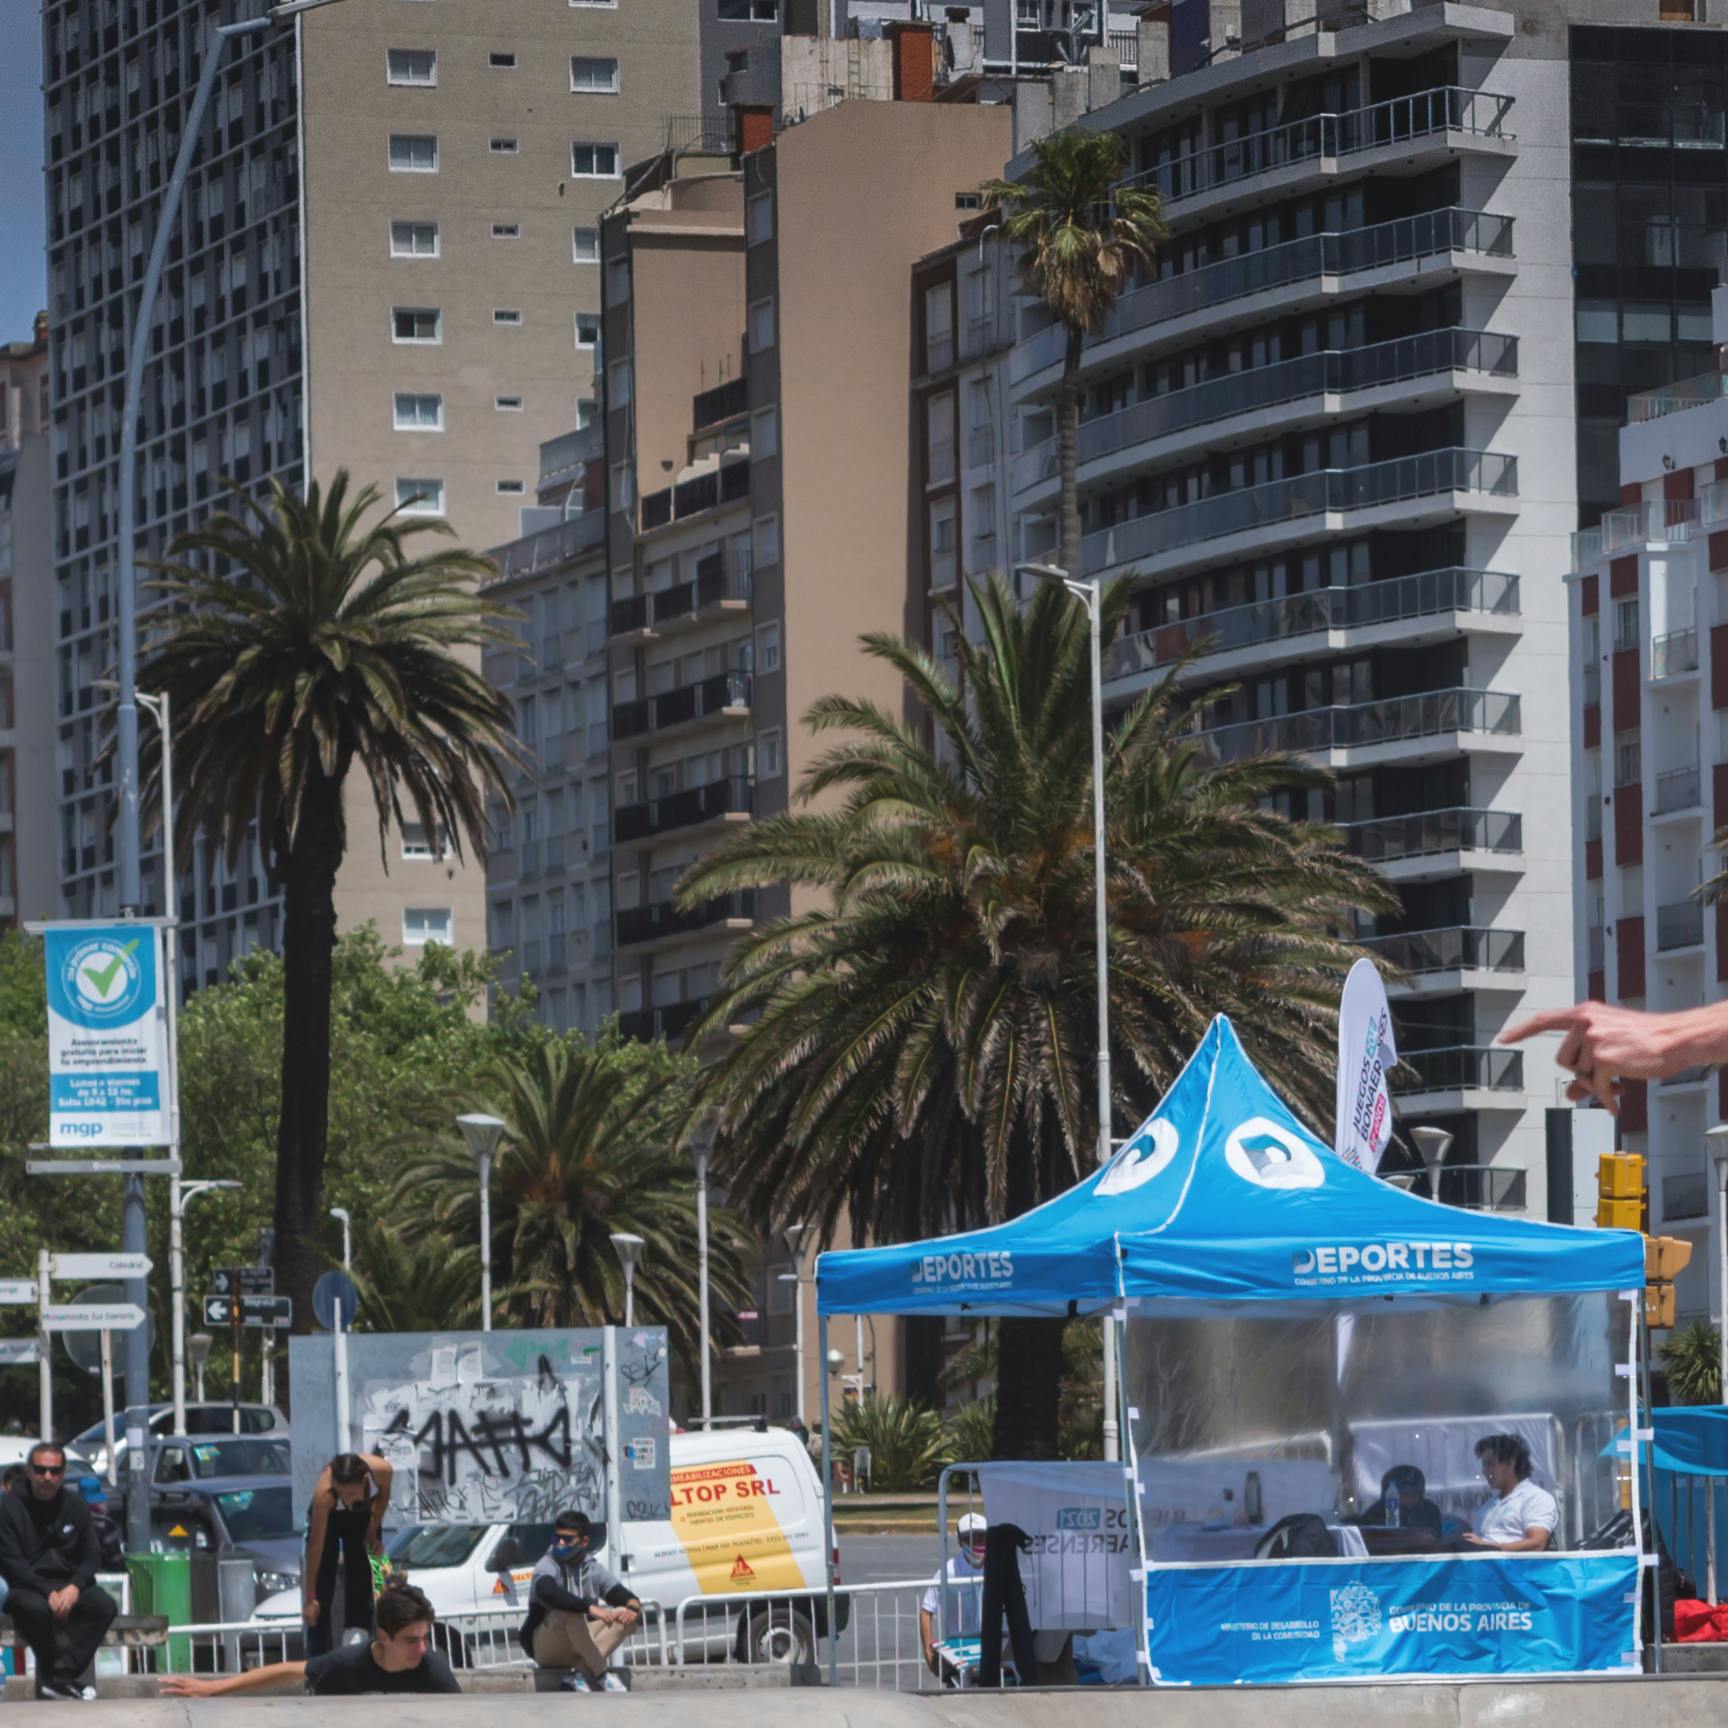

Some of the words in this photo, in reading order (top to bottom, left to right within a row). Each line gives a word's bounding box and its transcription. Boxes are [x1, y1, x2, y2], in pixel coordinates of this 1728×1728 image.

[60, 1122, 103, 1137] mgp
[1294, 1243, 1474, 1274] DEPORTES
[735, 1478, 780, 1499] SRL
[1389, 1613, 1472, 1633] BUENOS
[1477, 1612, 1532, 1631] AIRES
